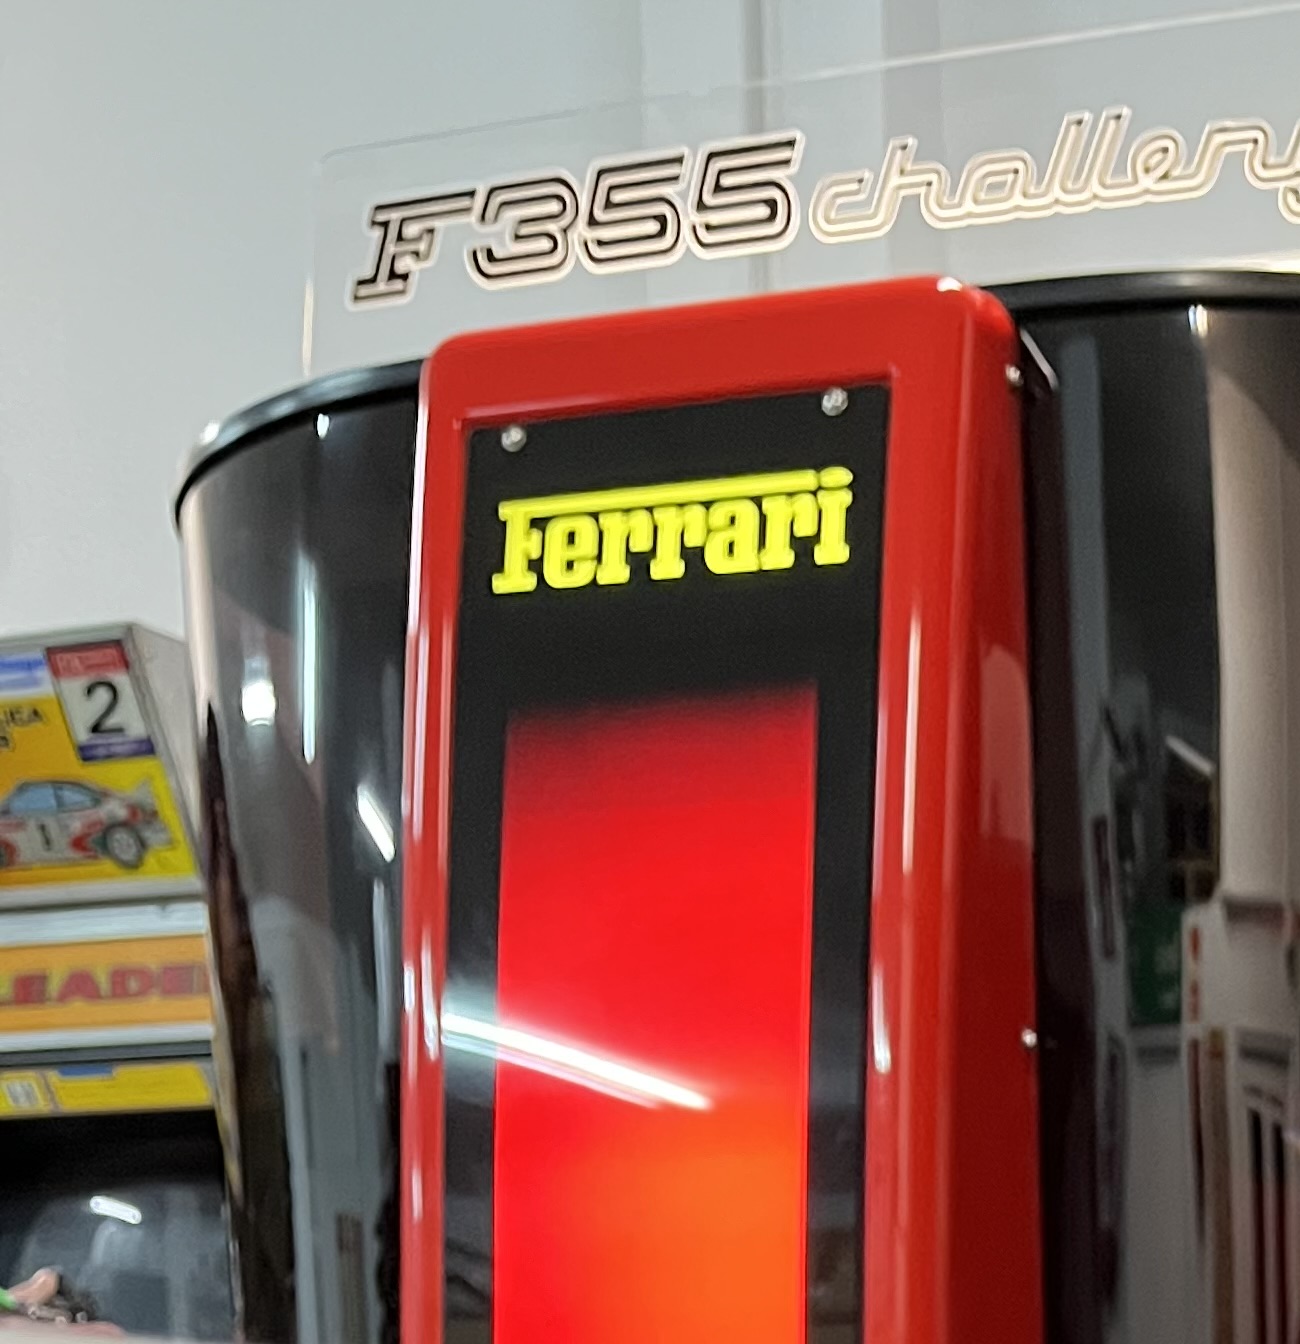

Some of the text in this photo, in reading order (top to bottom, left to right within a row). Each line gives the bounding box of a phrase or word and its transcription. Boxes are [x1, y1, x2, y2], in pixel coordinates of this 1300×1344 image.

[346, 128, 806, 311] F355
[491, 465, 854, 595] Ferrari
[86, 680, 125, 734] 2
[0, 962, 209, 1006] EADE
